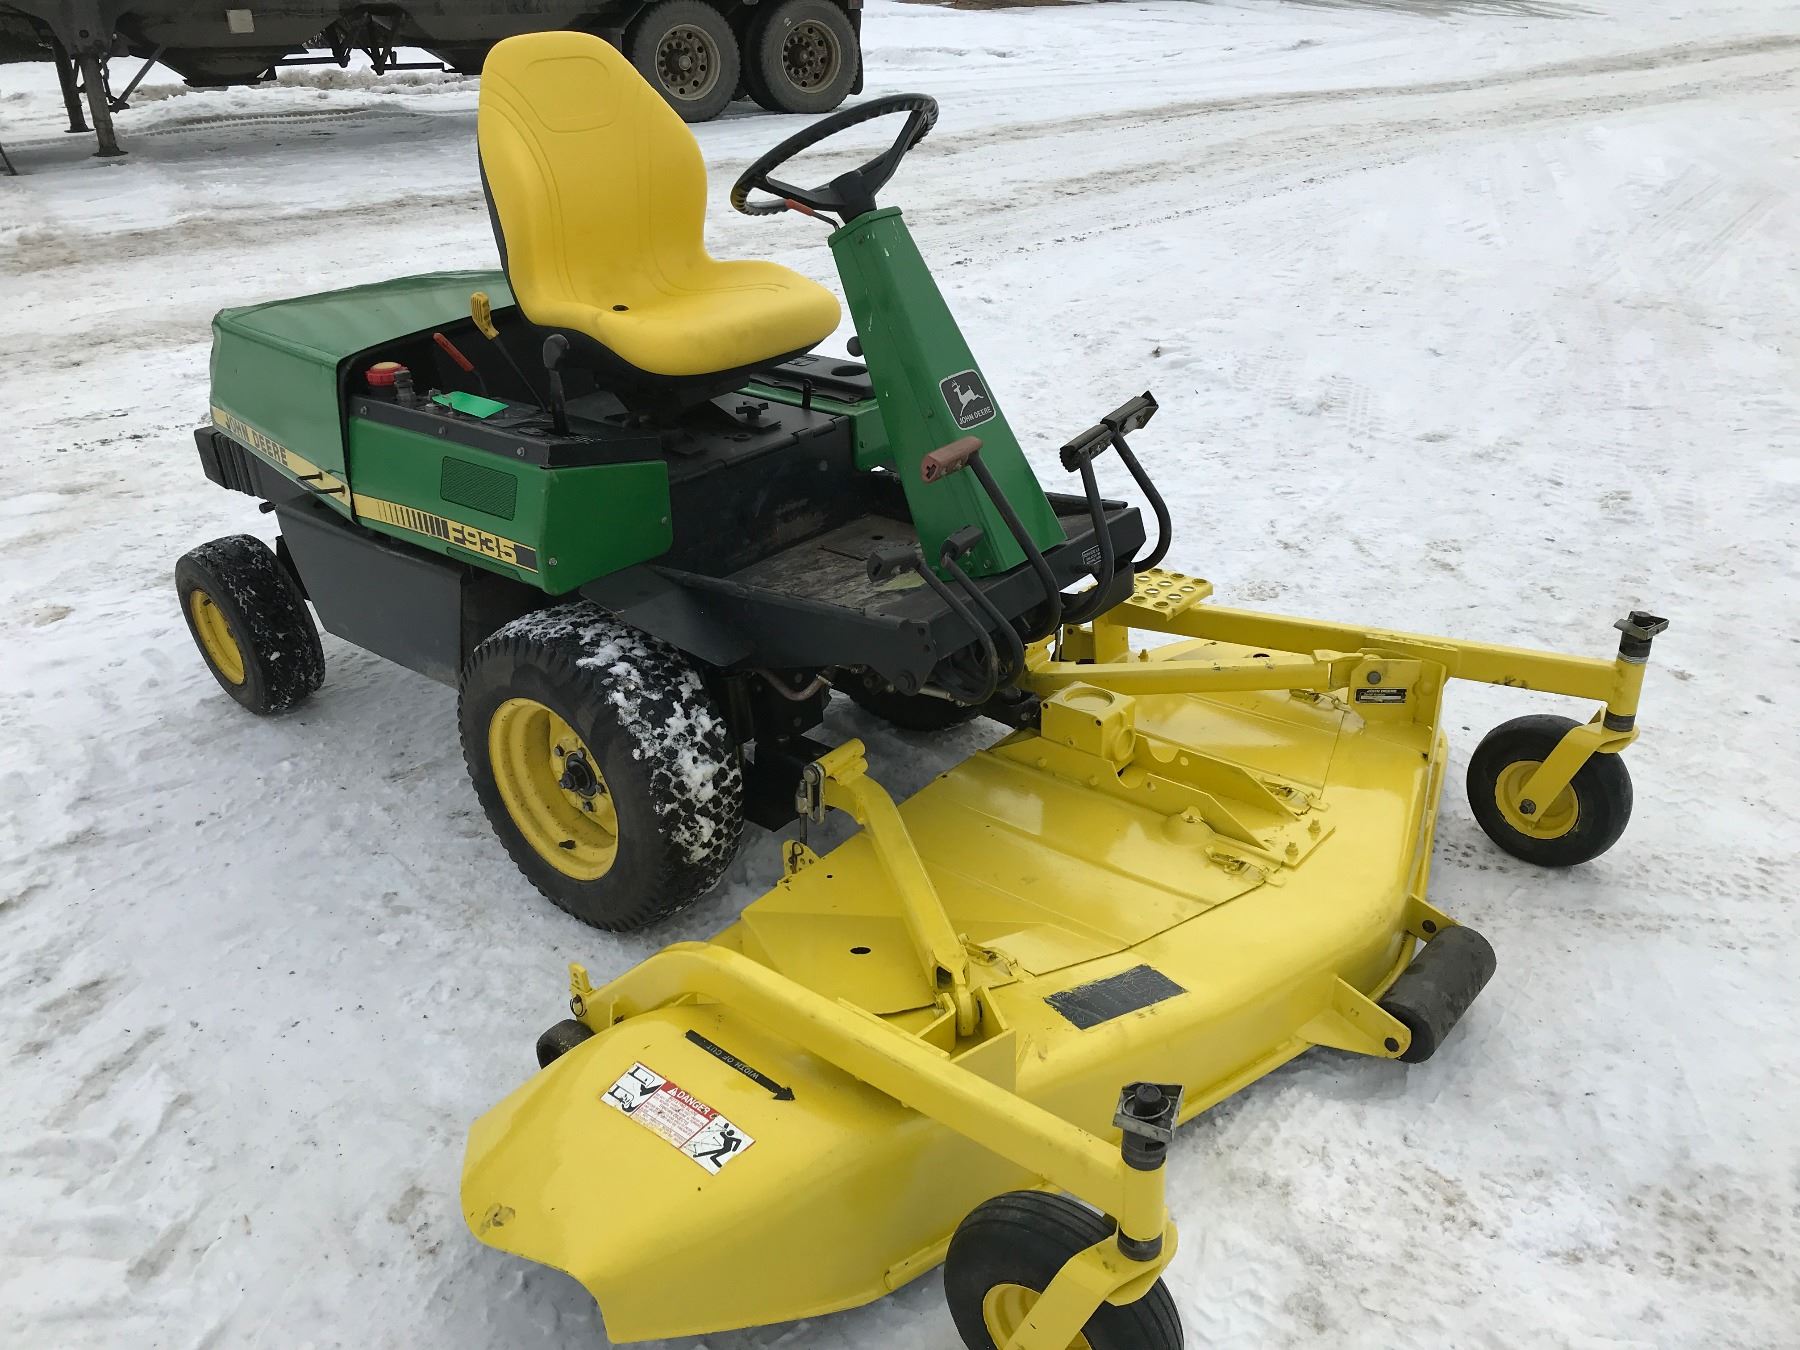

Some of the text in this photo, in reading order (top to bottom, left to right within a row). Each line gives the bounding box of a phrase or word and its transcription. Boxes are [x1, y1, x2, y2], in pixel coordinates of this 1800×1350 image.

[959, 406, 992, 424] JOHN DEERE
[225, 414, 289, 466] JOHN DEERE
[448, 524, 518, 565] F935
[705, 1044, 759, 1081] WIDTH OF CUT
[676, 1090, 711, 1116] DANGER
